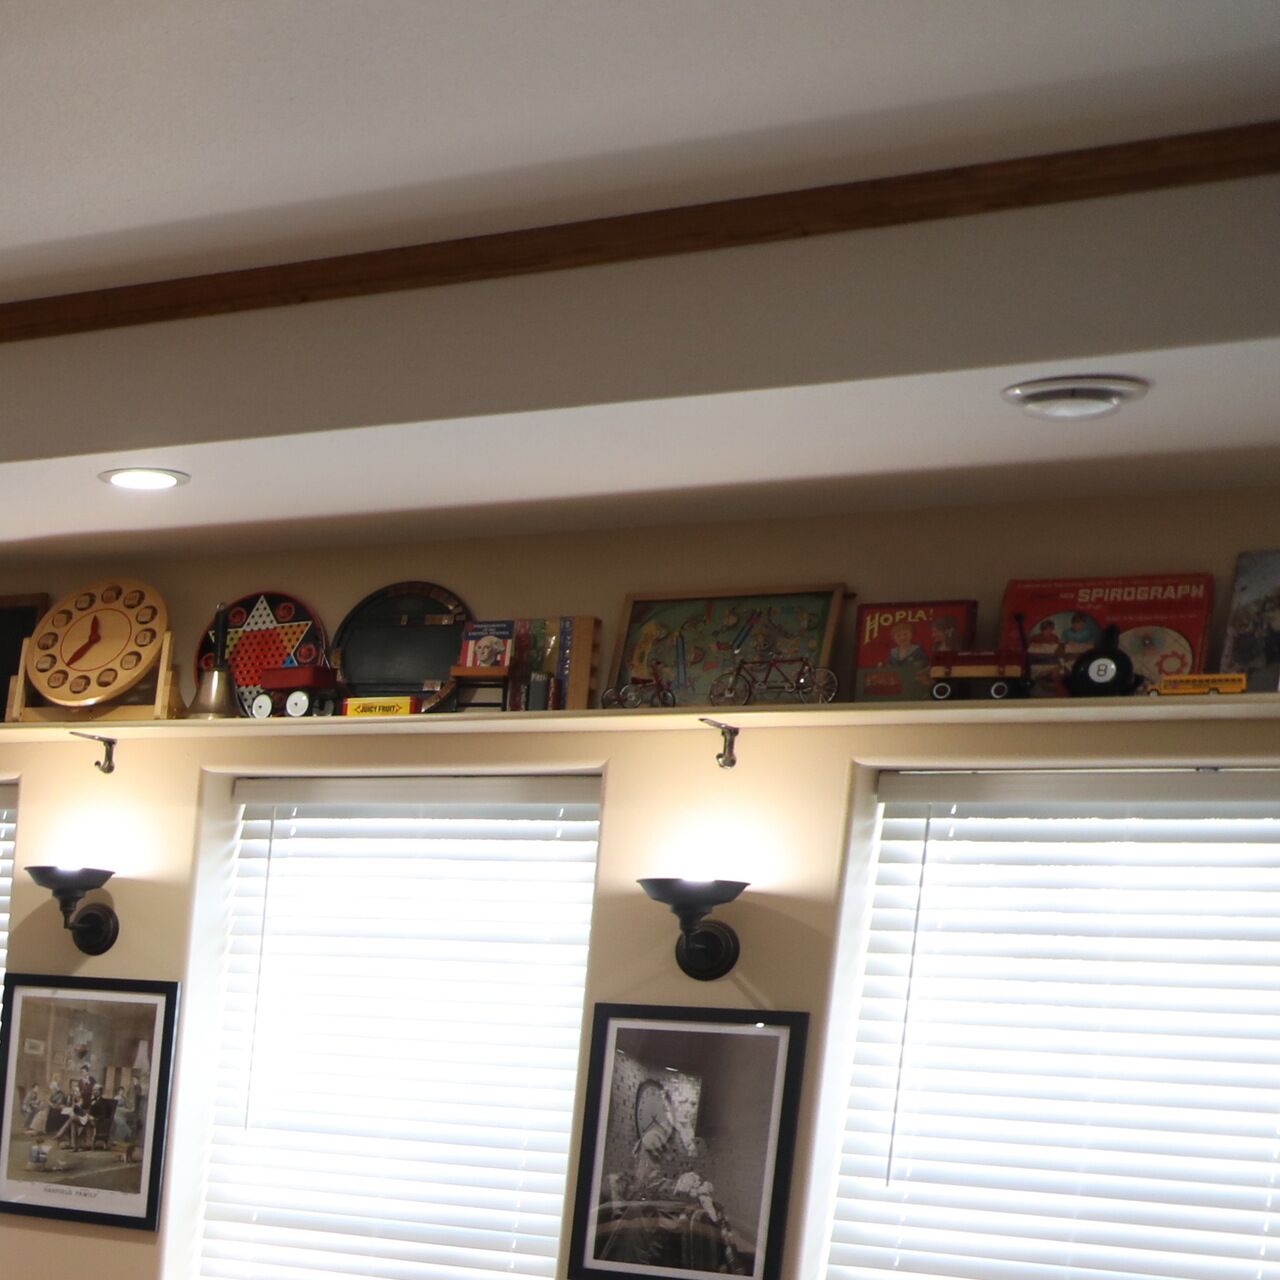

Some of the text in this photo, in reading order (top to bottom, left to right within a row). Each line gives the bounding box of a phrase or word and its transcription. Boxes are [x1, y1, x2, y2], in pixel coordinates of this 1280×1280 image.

[1077, 584, 1204, 602] SPIROGRAPH
[864, 608, 934, 645] HOPLA!
[1096, 664, 1108, 676] 8
[378, 704, 395, 712] FRUIT
